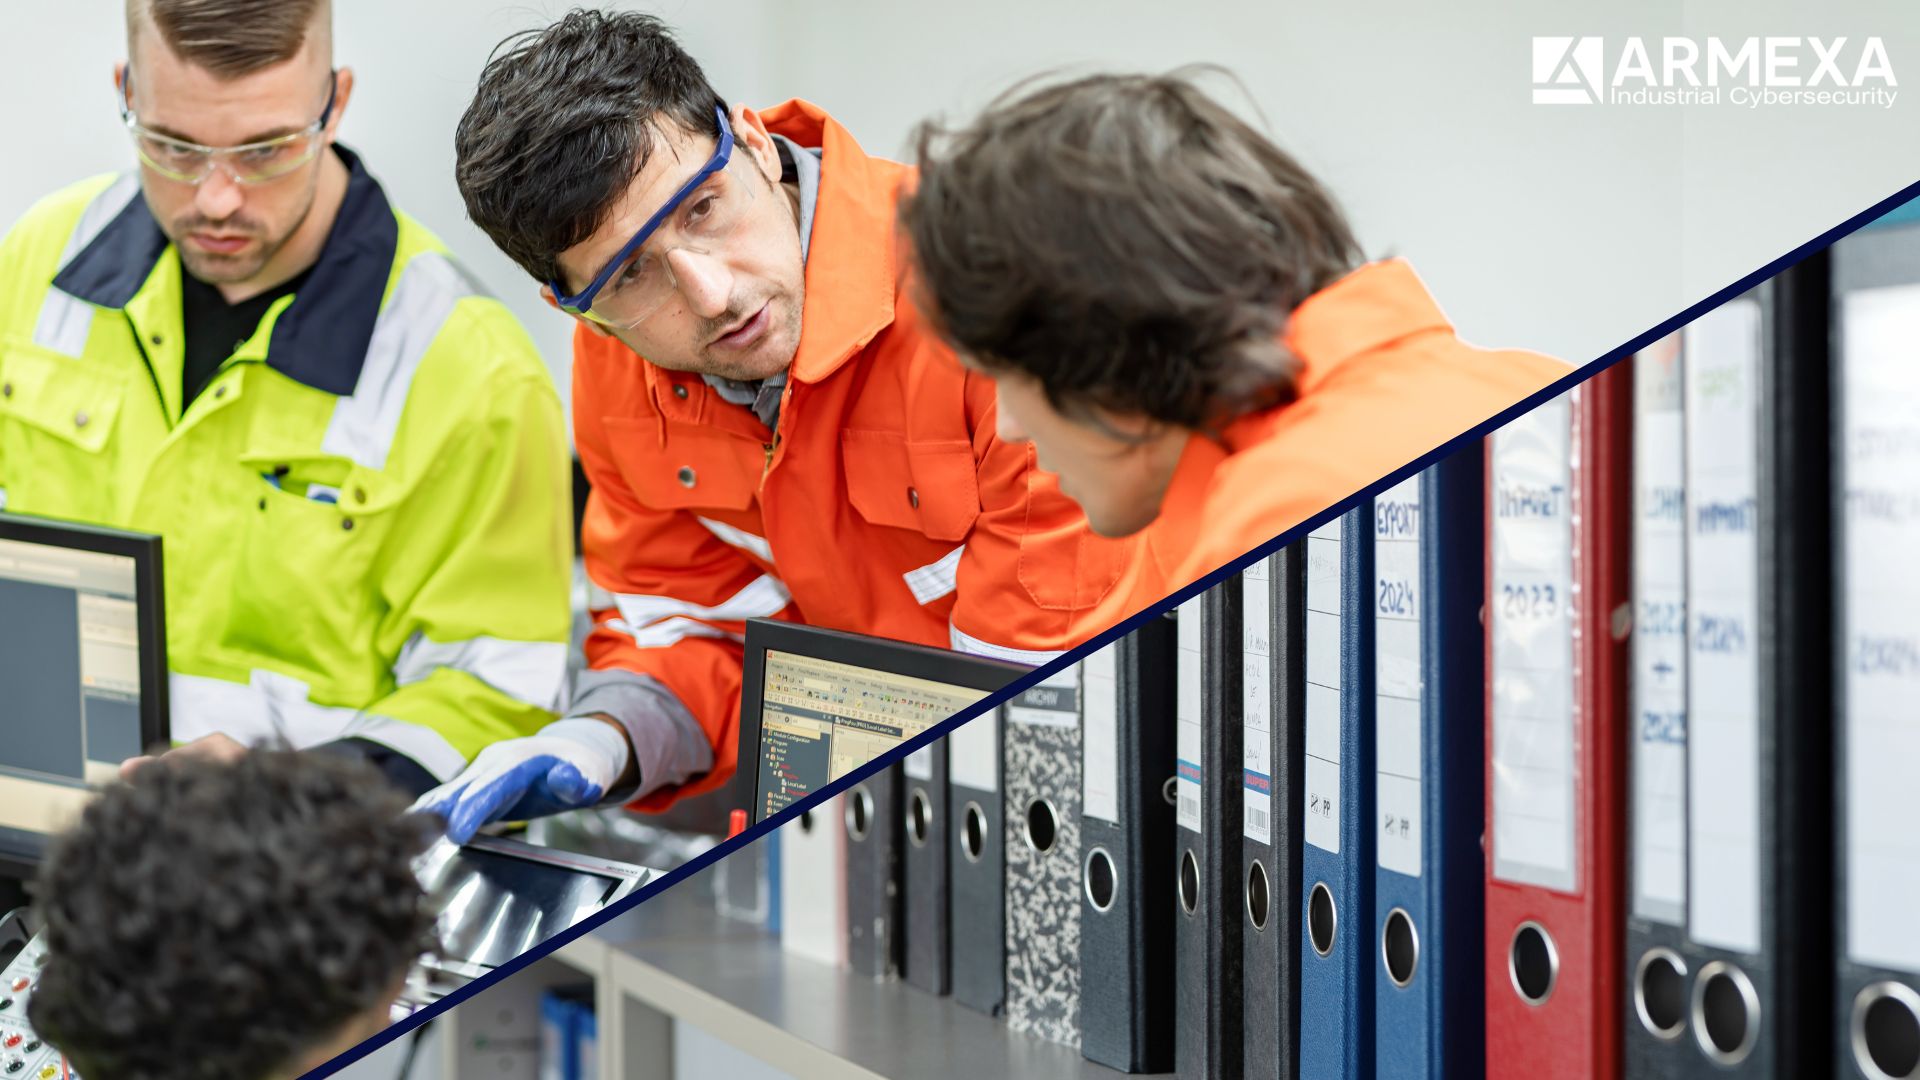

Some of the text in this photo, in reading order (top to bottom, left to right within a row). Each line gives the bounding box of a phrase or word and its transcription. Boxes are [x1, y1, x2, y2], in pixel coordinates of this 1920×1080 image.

[1377, 501, 1420, 538] EXPORT
[1379, 579, 1414, 616] 2024
[1503, 584, 1558, 620] 2023
[1323, 799, 1331, 816] PP
